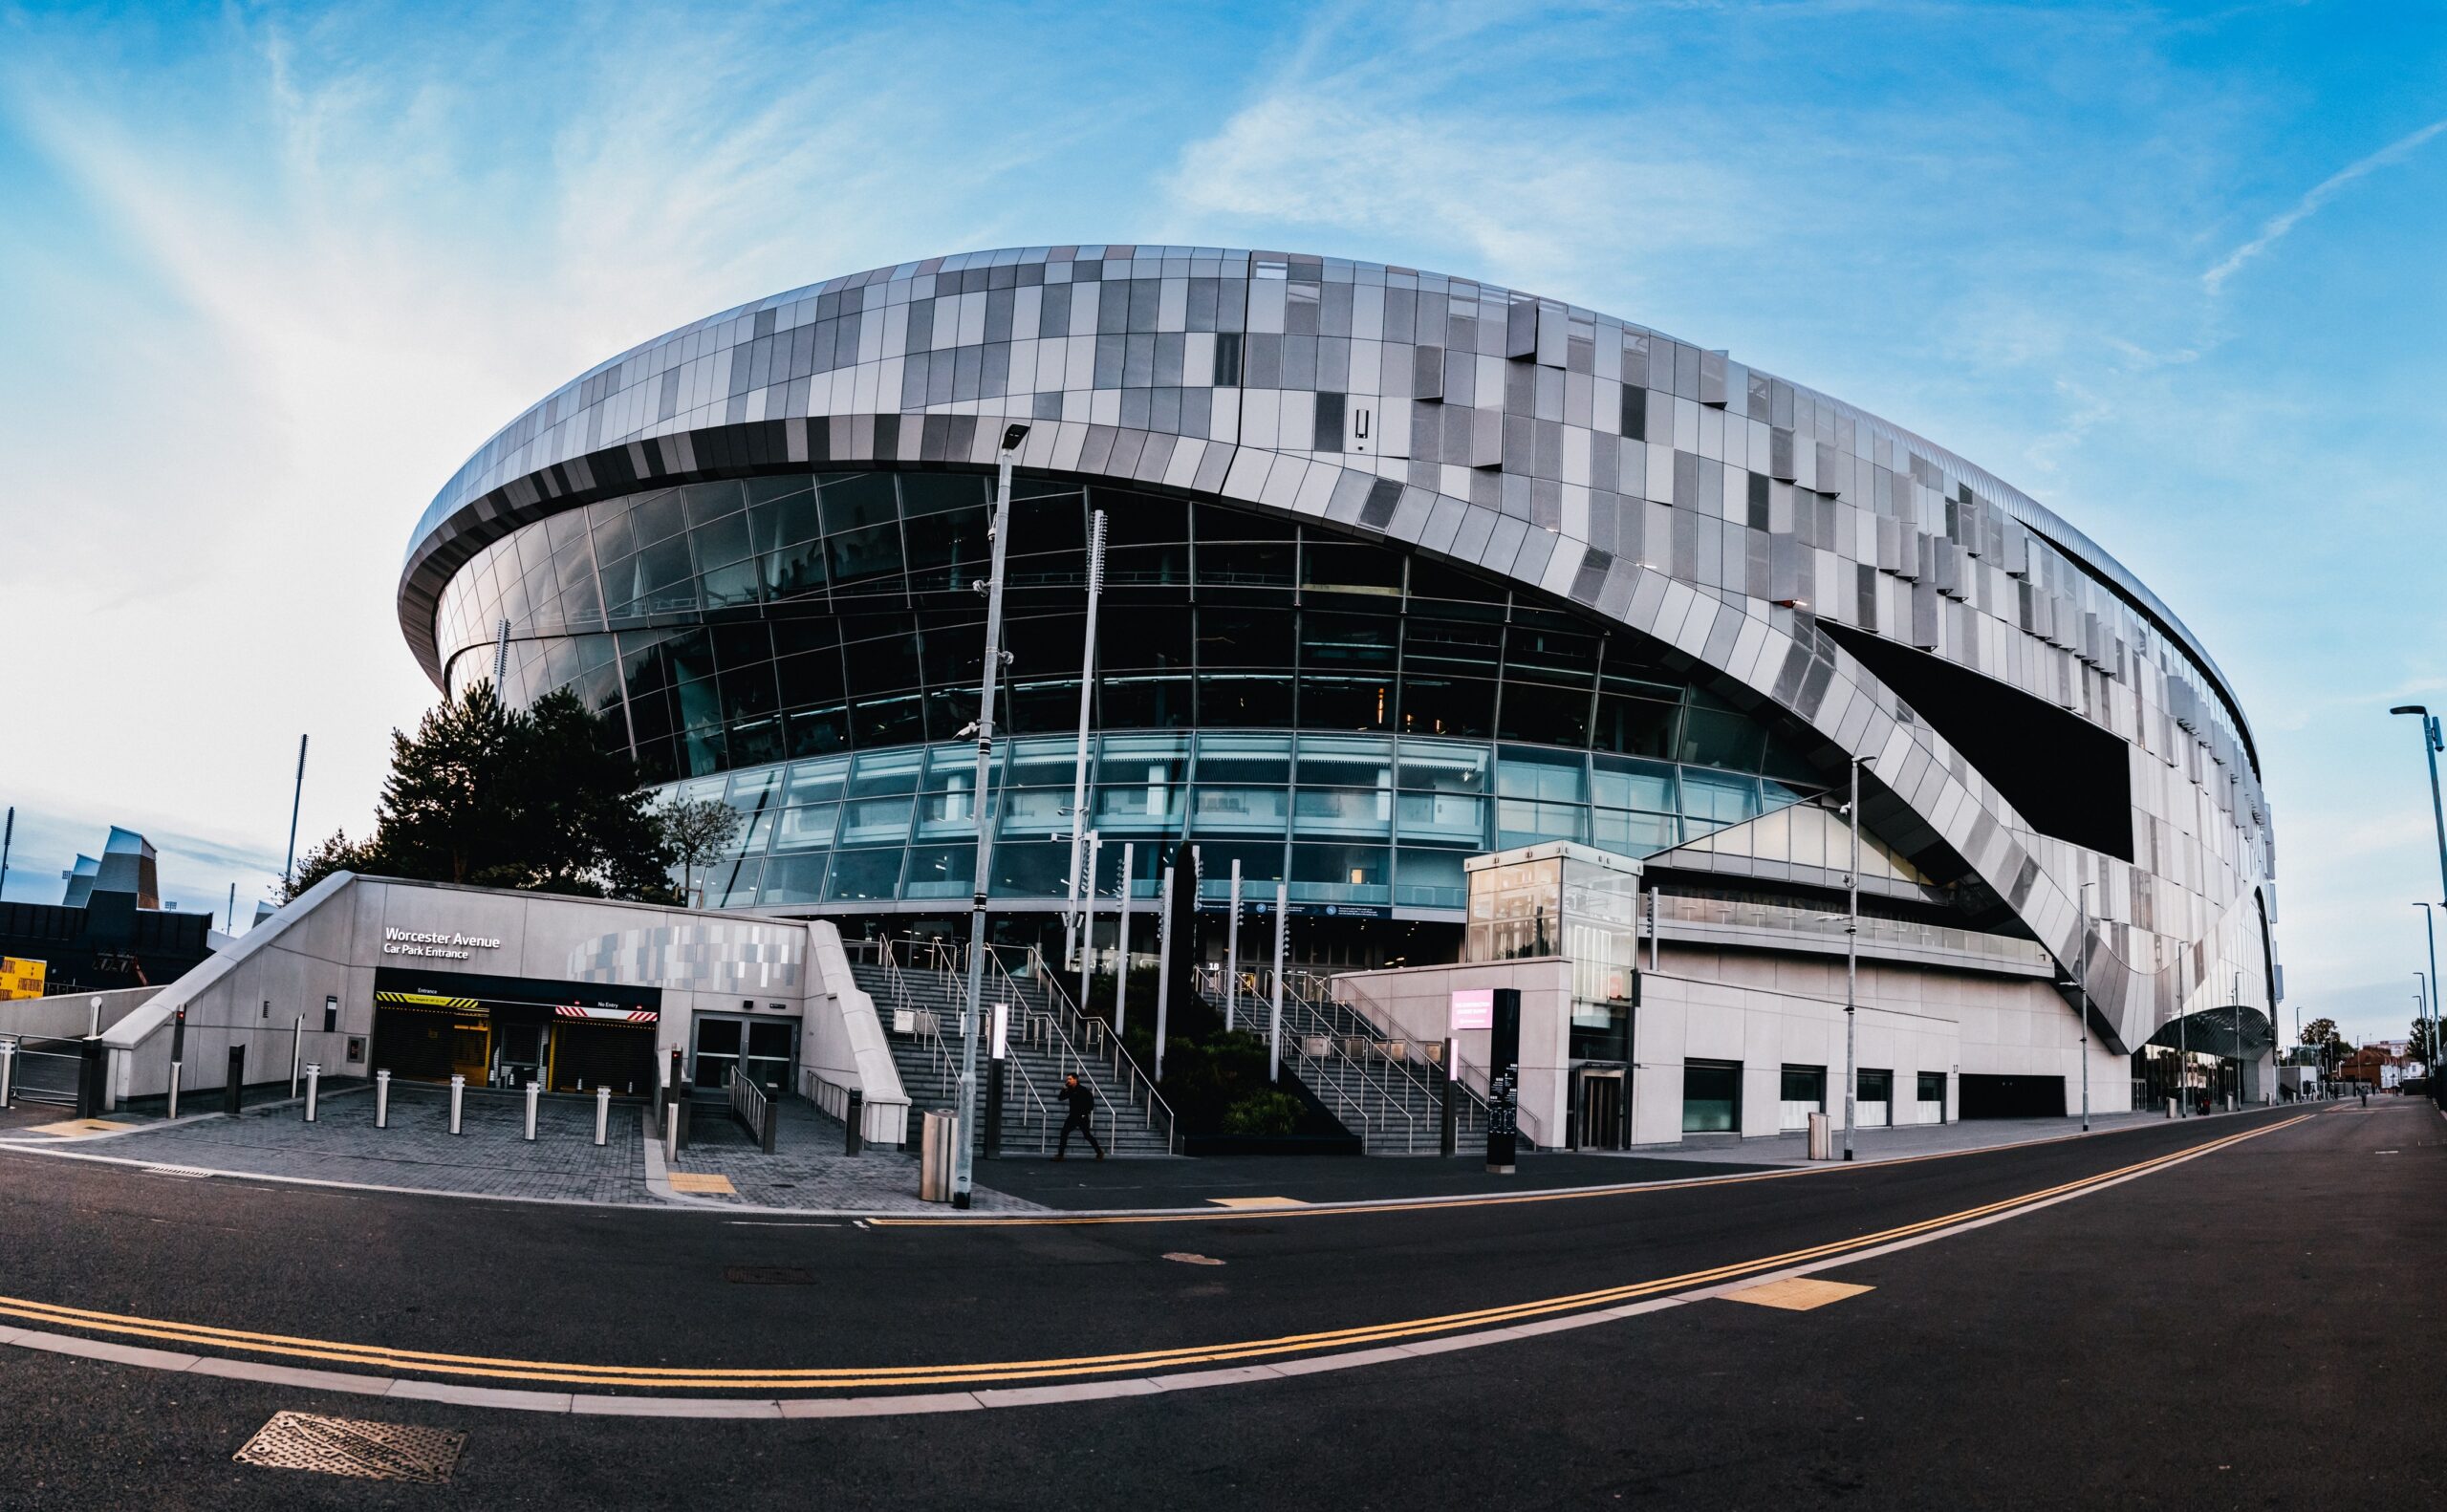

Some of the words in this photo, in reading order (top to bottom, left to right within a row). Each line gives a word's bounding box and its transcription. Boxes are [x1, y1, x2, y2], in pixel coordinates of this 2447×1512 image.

[385, 927, 451, 944] Worcester
[453, 933, 501, 948] Avenue
[383, 943, 401, 954] Car
[401, 944, 423, 956] Park
[425, 946, 468, 960] Entrance
